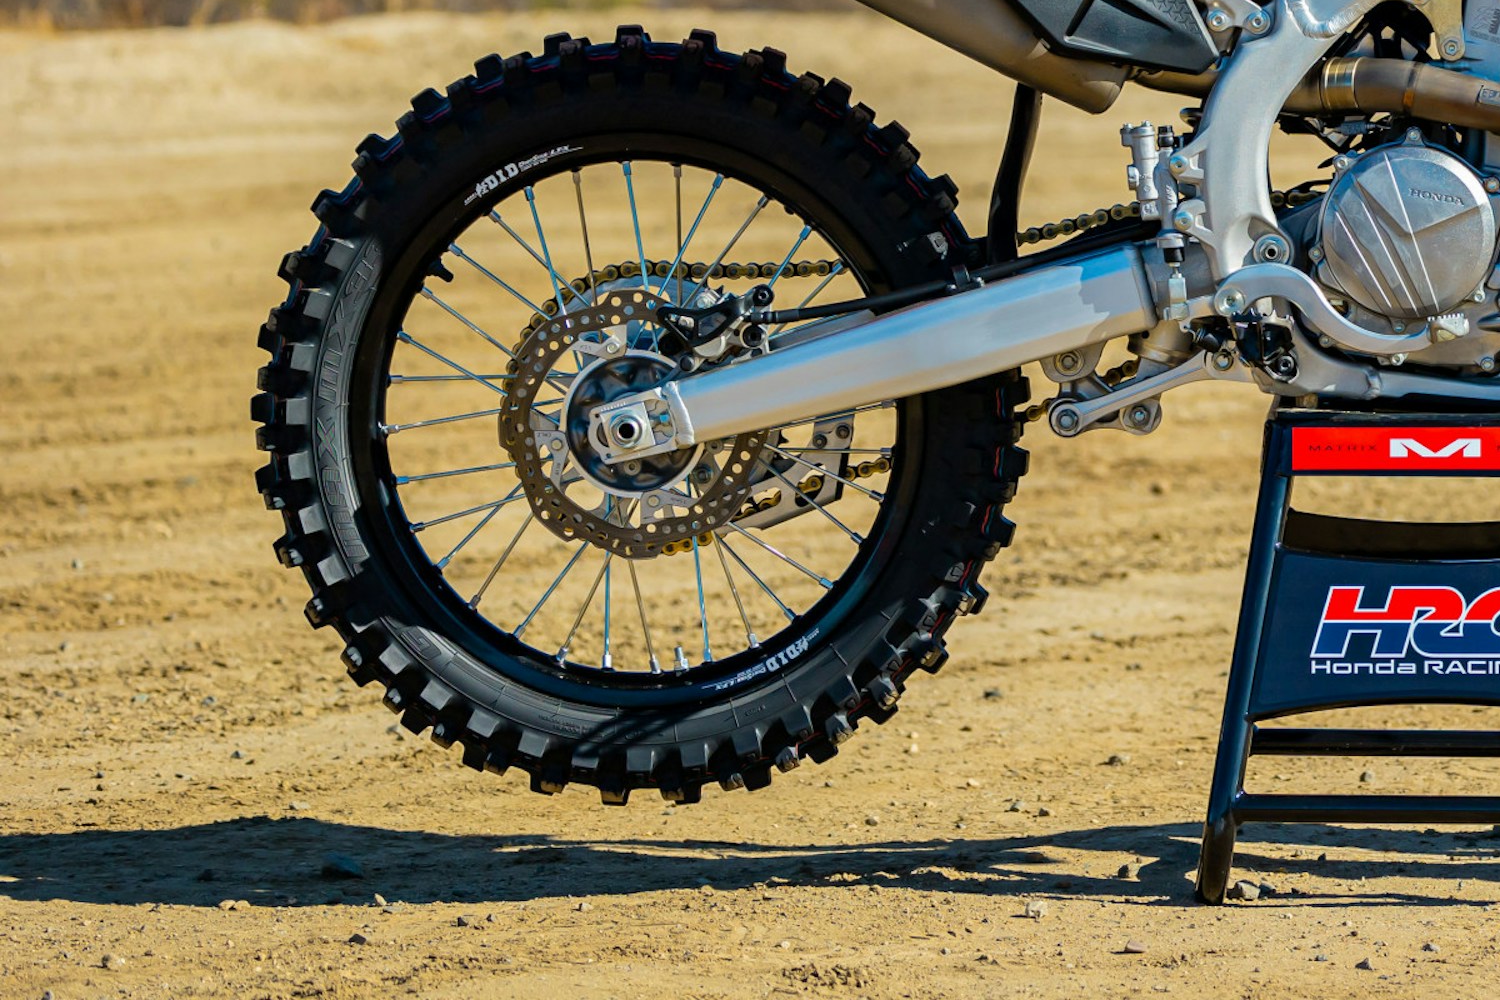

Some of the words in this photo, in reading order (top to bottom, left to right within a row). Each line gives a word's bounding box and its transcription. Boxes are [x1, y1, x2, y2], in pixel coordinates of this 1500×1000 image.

[1408, 187, 1465, 207] HONDA
[1308, 443, 1378, 452] MATRIX
[1310, 659, 1417, 675] Honda
